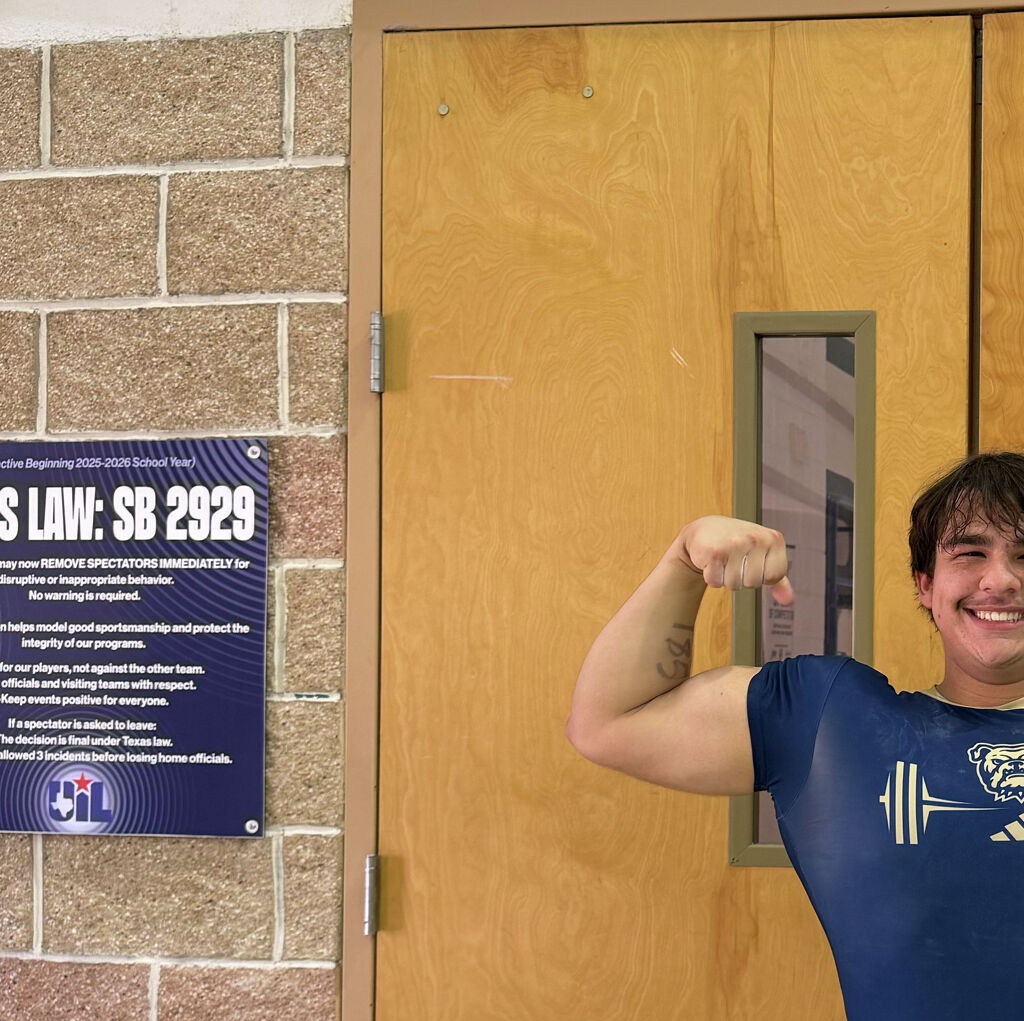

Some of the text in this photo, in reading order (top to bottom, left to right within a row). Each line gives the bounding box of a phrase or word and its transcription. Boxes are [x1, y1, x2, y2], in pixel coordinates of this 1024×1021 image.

[0, 456, 196, 470] ctive Beginning 2025-2026 School Year)
[28, 487, 104, 541] LAW:
[113, 486, 157, 541] SB
[166, 485, 255, 541] 2929
[18, 560, 40, 569] now
[40, 558, 86, 569] REMOVE
[86, 558, 158, 569] SPECTATORS
[159, 558, 233, 569] IMMEDIATELY
[234, 558, 250, 569] for
[47, 576, 59, 585] or
[59, 574, 127, 587] inappropriate
[128, 574, 175, 585] behavior.
[28, 590, 141, 603] No warning is required.
[8, 621, 35, 634] helps
[36, 621, 68, 632] model
[68, 621, 95, 634] good
[95, 622, 171, 635] sportsmanship
[172, 622, 192, 633] and
[192, 623, 231, 635] protect
[232, 623, 250, 634] the
[21, 637, 147, 651] integrity of our programs.
[14, 663, 32, 673] our
[32, 662, 72, 675] players,
[72, 663, 90, 673] not
[90, 663, 128, 675] against
[128, 663, 146, 674] the
[146, 663, 175, 674] other
[175, 664, 206, 674] team.
[1, 677, 197, 692] officials and visiting teams with respect.
[27, 694, 62, 705] events
[62, 694, 102, 707] positive
[102, 695, 119, 706] for
[118, 697, 170, 708] everyone.
[8, 718, 157, 731] If a spectator is asked to leave:
[15, 734, 58, 745] decision
[58, 735, 68, 746] is
[68, 735, 90, 746] final
[90, 735, 121, 746] under
[122, 736, 152, 747] Texas
[152, 736, 174, 747] law.
[36, 750, 44, 761] 3
[44, 750, 91, 762] incidents
[91, 751, 126, 762] before
[126, 752, 158, 765] losing
[158, 752, 188, 763] home
[188, 753, 233, 764] officials.
[48, 780, 112, 822] UIL
